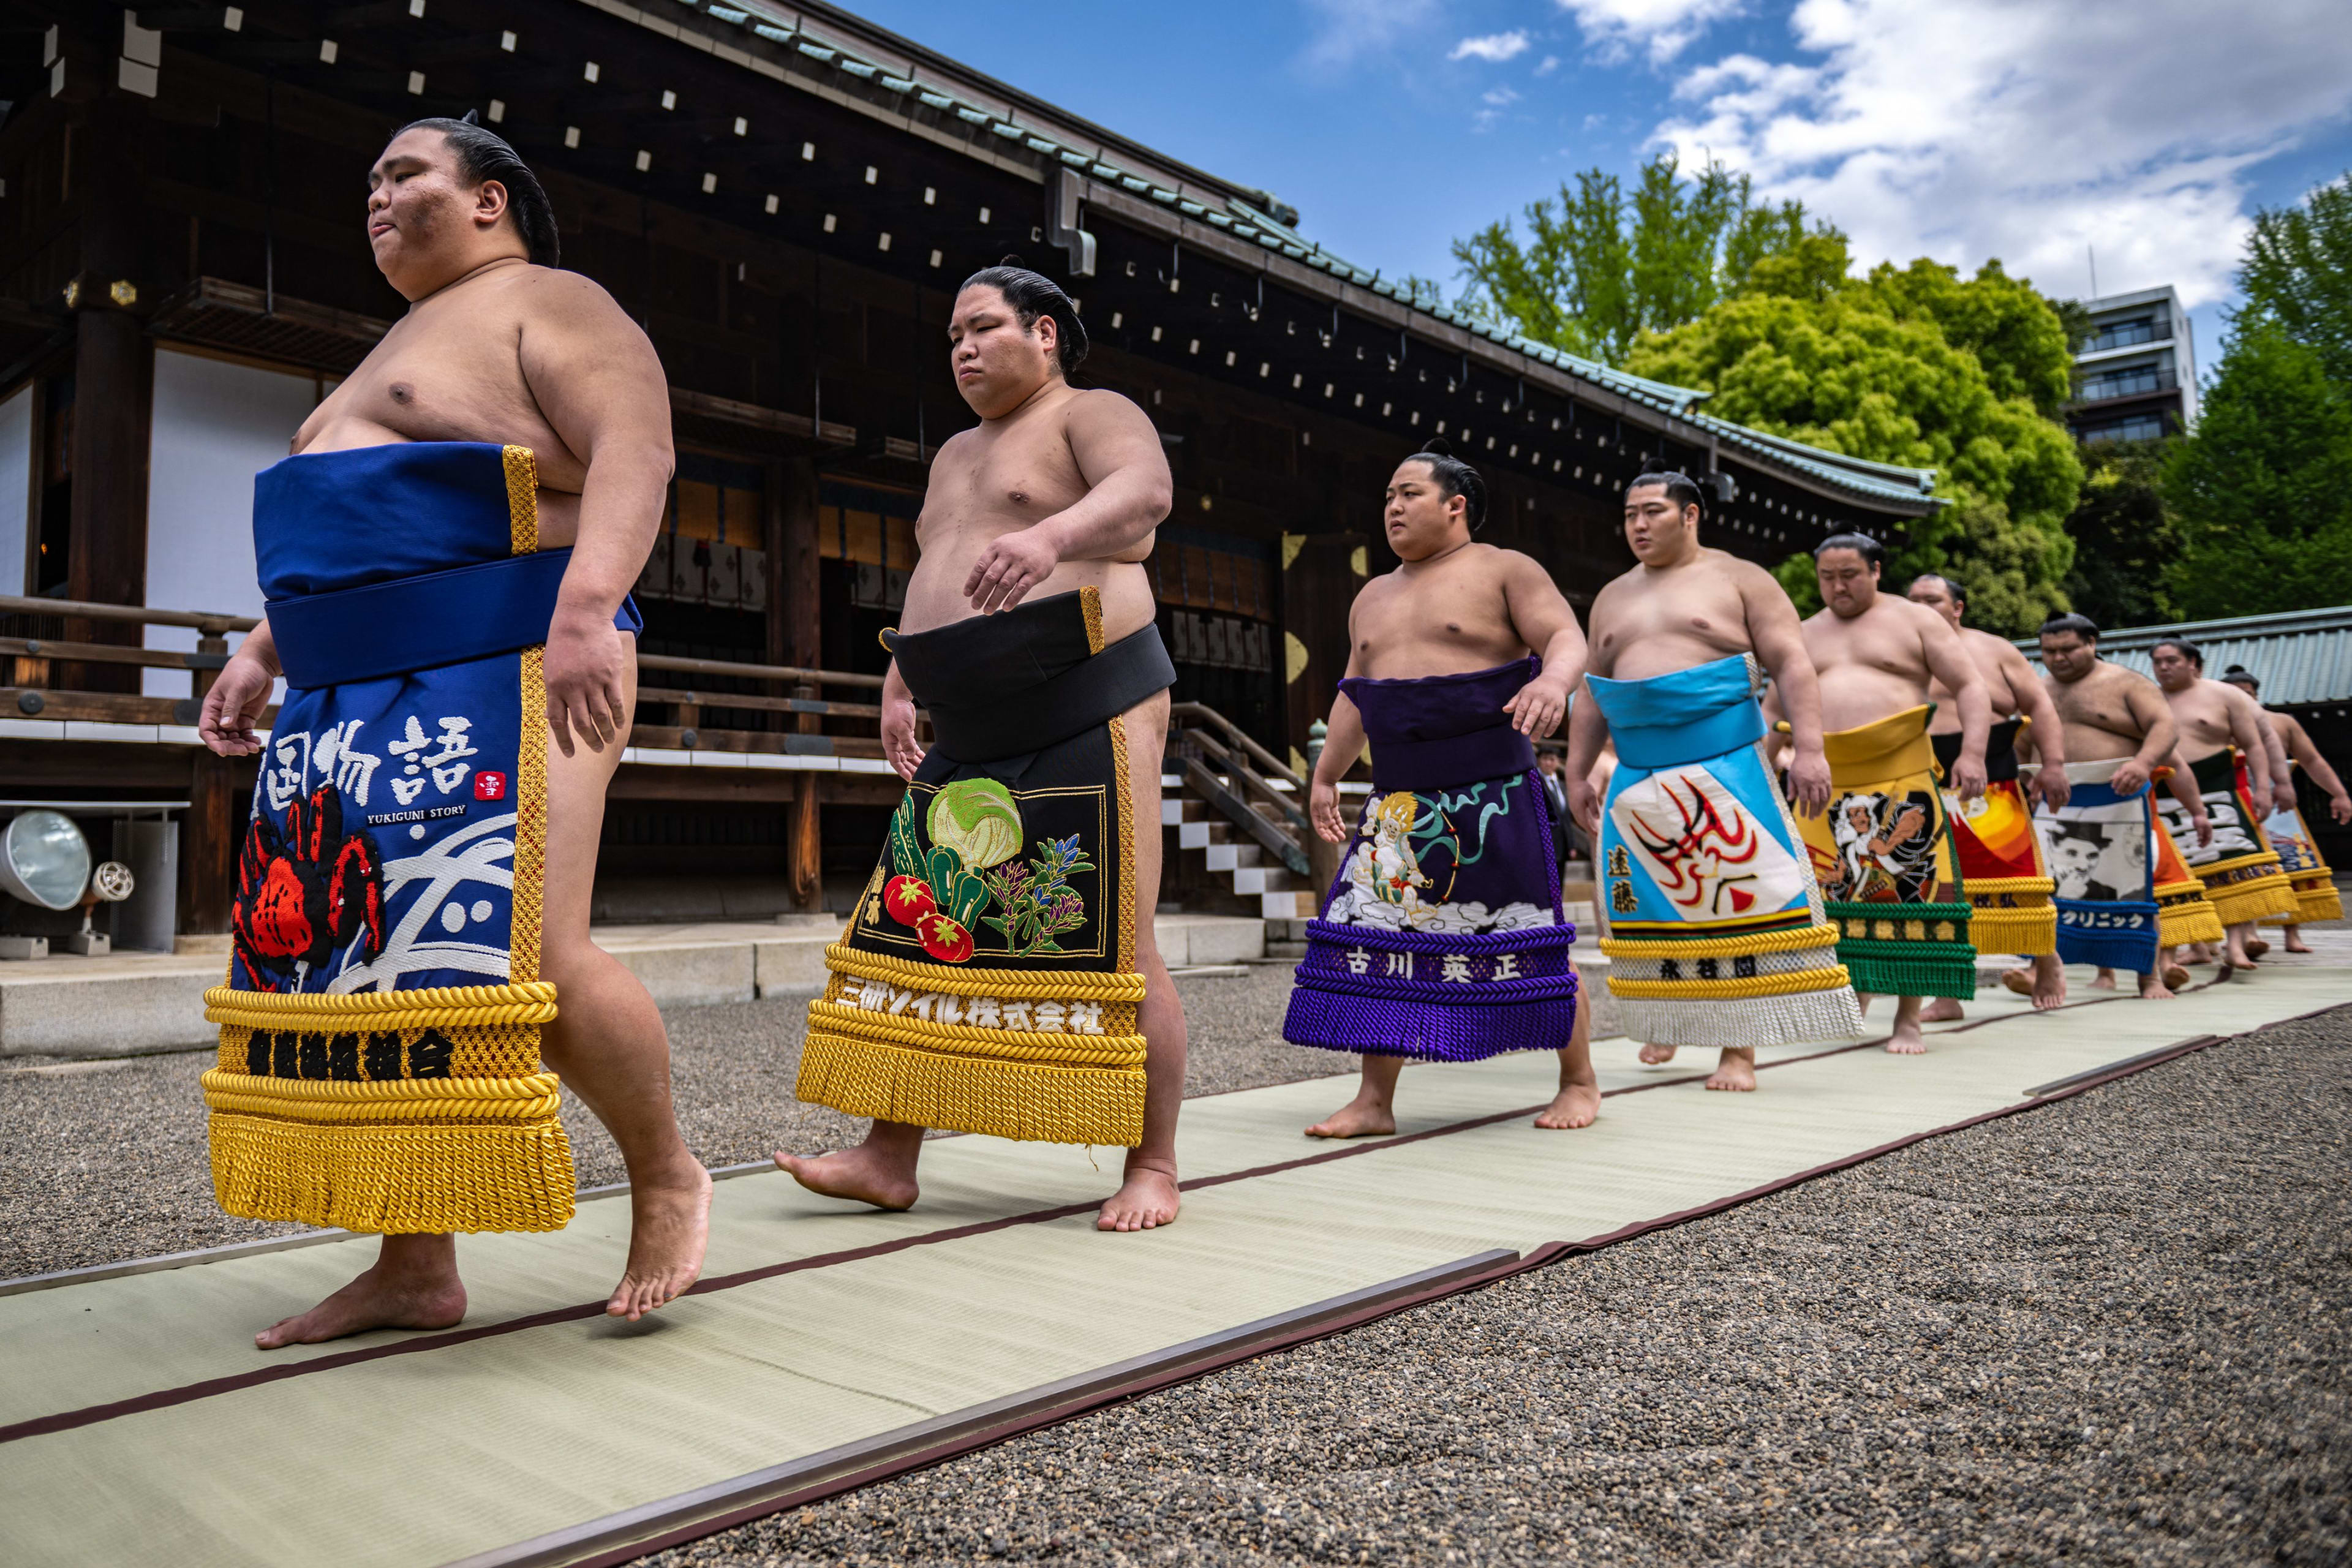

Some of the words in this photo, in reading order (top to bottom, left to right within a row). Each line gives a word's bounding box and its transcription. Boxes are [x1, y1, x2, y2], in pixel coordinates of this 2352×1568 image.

[251, 715, 479, 821] 国物語
[368, 810, 425, 824] YUKIGUNI
[430, 804, 466, 818] STORY
[2061, 910, 2144, 929] クリニック
[1346, 945, 1522, 984] 古川英正
[835, 975, 1105, 1035] 三研ソイル株式会社
